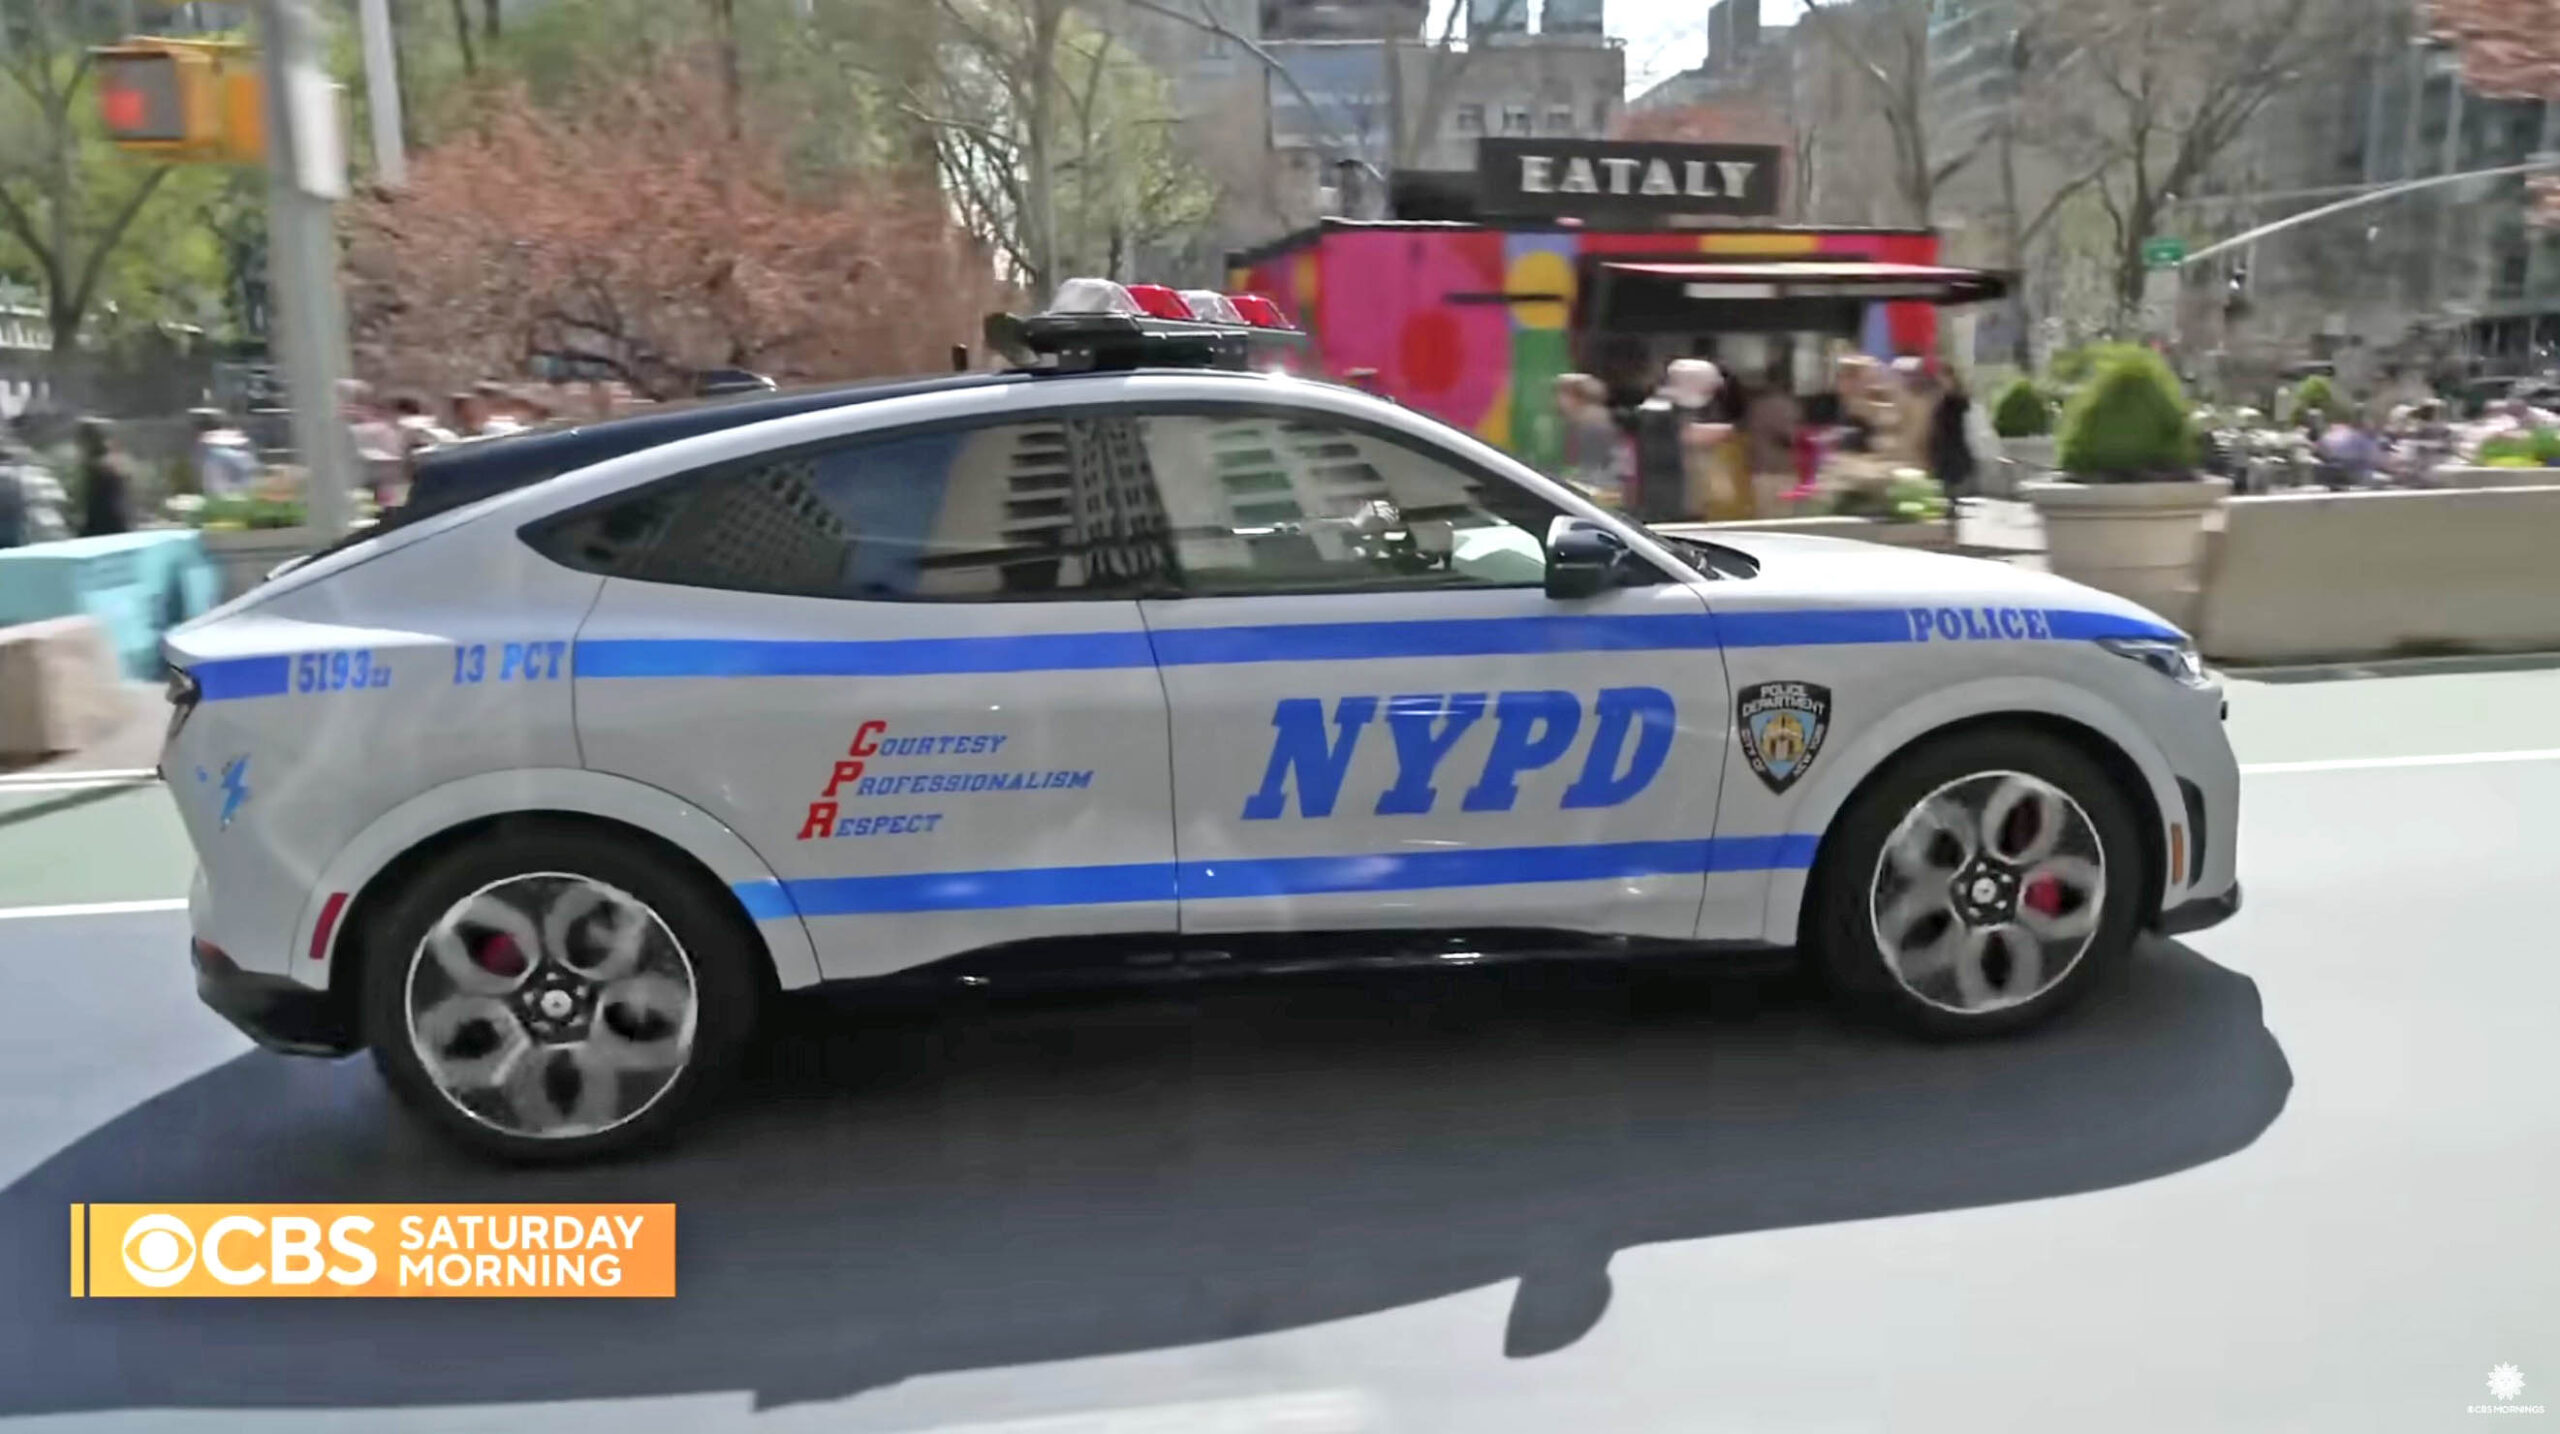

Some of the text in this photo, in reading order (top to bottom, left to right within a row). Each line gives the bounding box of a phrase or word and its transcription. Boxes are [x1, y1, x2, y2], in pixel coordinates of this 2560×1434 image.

[1518, 155, 1757, 198] EATALY
[1909, 607, 2049, 642] POLICE
[453, 640, 566, 684] 13 PCT
[848, 720, 1007, 757] COURTESY
[1240, 686, 1676, 820] NYPD
[822, 761, 1095, 797] PROFESSIONALISM
[797, 802, 943, 840] RESPECT
